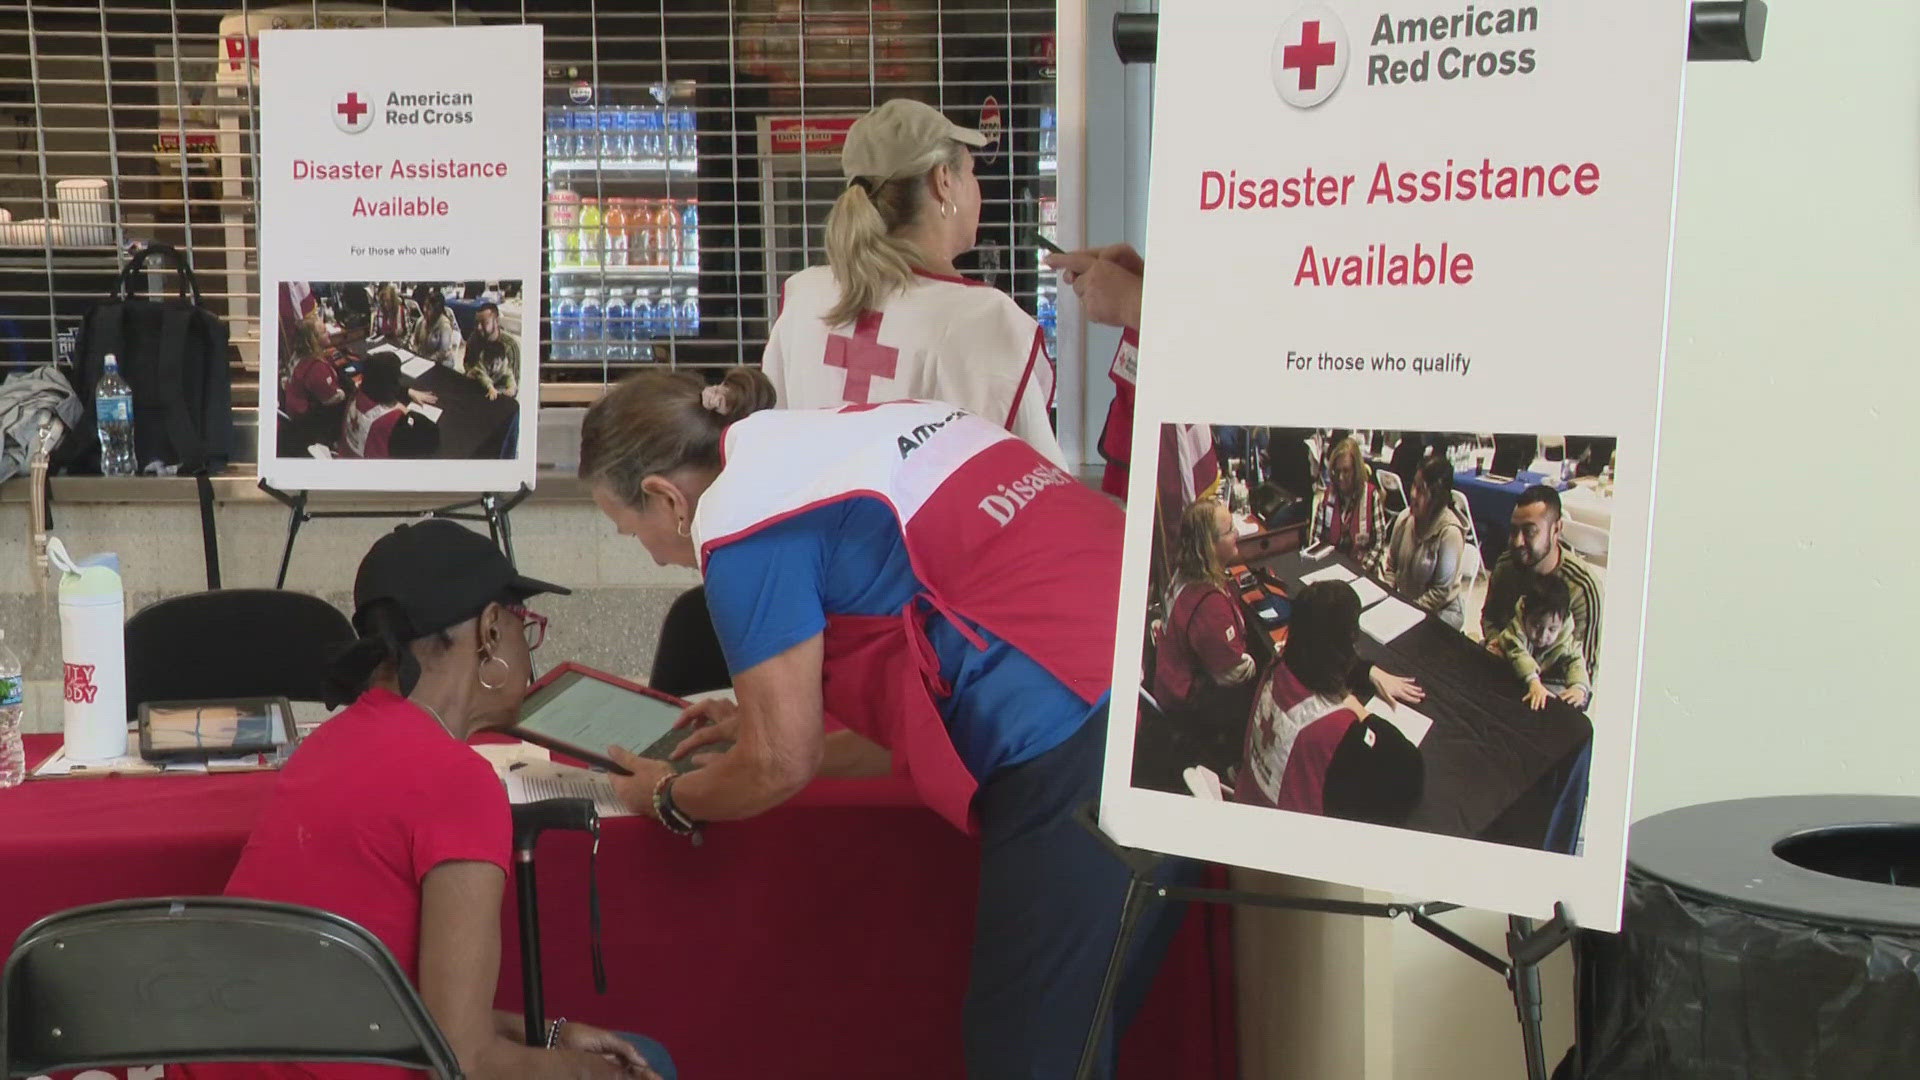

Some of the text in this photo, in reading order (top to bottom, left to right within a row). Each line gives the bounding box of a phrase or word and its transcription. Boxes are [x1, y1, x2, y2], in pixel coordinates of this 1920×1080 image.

[1370, 5, 1538, 46] American
[1367, 46, 1536, 86] Red Cross
[386, 91, 473, 106] American
[385, 108, 473, 125] Red Cross
[293, 158, 508, 180] Disaster Assistance
[1200, 158, 1600, 210] Disaster Assistance
[352, 196, 449, 217] Available
[350, 244, 451, 256] For those who qualify
[1294, 242, 1474, 287] Available
[1286, 351, 1471, 376] For those who qualify
